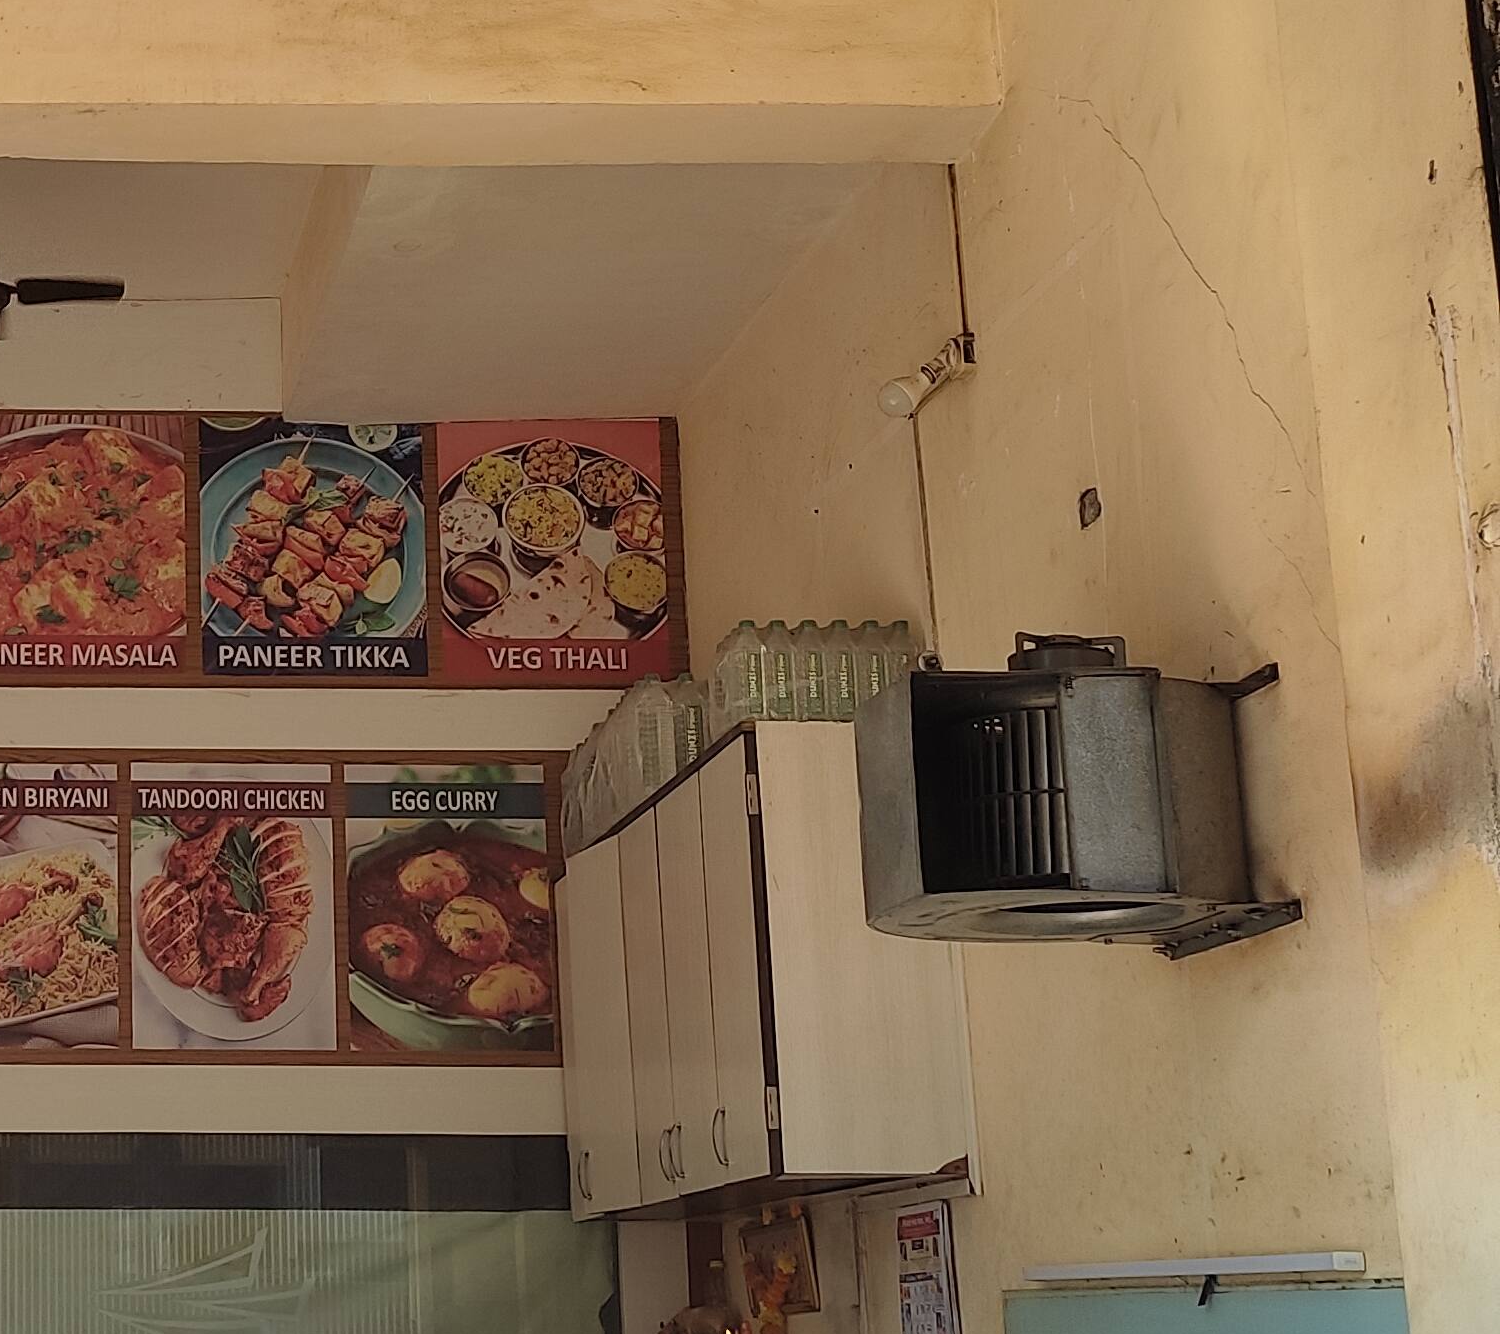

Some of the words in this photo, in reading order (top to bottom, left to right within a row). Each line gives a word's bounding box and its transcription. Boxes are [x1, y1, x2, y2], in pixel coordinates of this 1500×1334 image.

[71, 643, 177, 667] MASALA
[218, 644, 322, 668] PANEER
[329, 645, 411, 669] TIKKA
[486, 647, 542, 669] VEG
[549, 647, 628, 671] THALI
[24, 786, 109, 809] BIRYANI
[137, 788, 239, 810] TANDOORI
[243, 788, 325, 811] CHICKEN
[390, 789, 430, 812] EGG
[435, 790, 498, 813] CURRY
